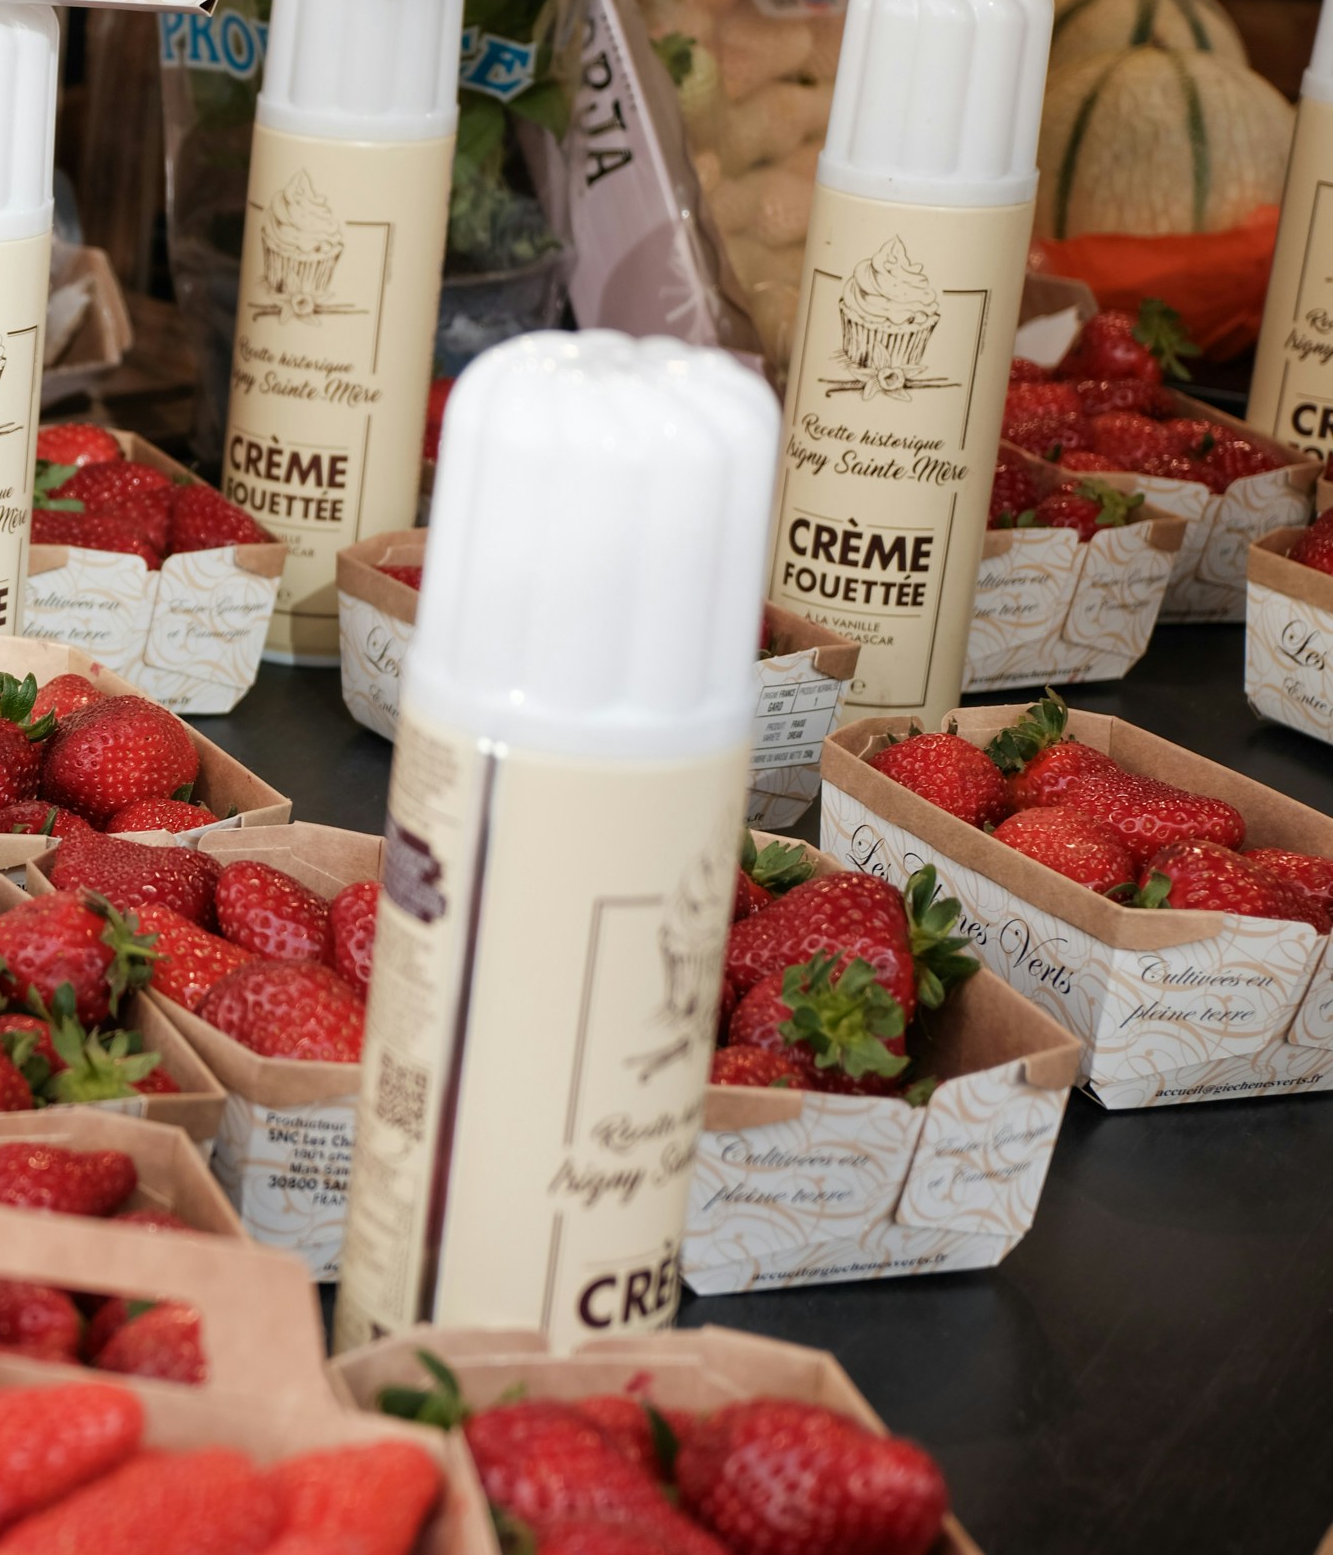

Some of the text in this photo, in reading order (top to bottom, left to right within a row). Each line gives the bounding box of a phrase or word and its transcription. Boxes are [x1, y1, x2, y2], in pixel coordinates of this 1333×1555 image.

[278, 349, 354, 375] historique
[259, 369, 382, 406] Sainte-Mère
[801, 412, 945, 454] Recette historique
[230, 435, 349, 489] CRÈME
[786, 428, 969, 484] Isigny Sainte-Mère
[788, 517, 933, 573] CRÈME
[783, 561, 926, 608] FOUETTÉE
[833, 617, 881, 634] VANILLE
[1276, 619, 1325, 672] Les
[1284, 676, 1328, 712] Entre
[844, 824, 1072, 996] Les Verts
[1137, 955, 1273, 987] Cultivées en
[1119, 1000, 1255, 1029] pleine terre
[1155, 1073, 1324, 1098] accueil@giechenesverts.fr
[268, 1128, 300, 1144] SNC
[268, 1174, 317, 1190] 30800
[702, 1185, 854, 1212] pleine terre
